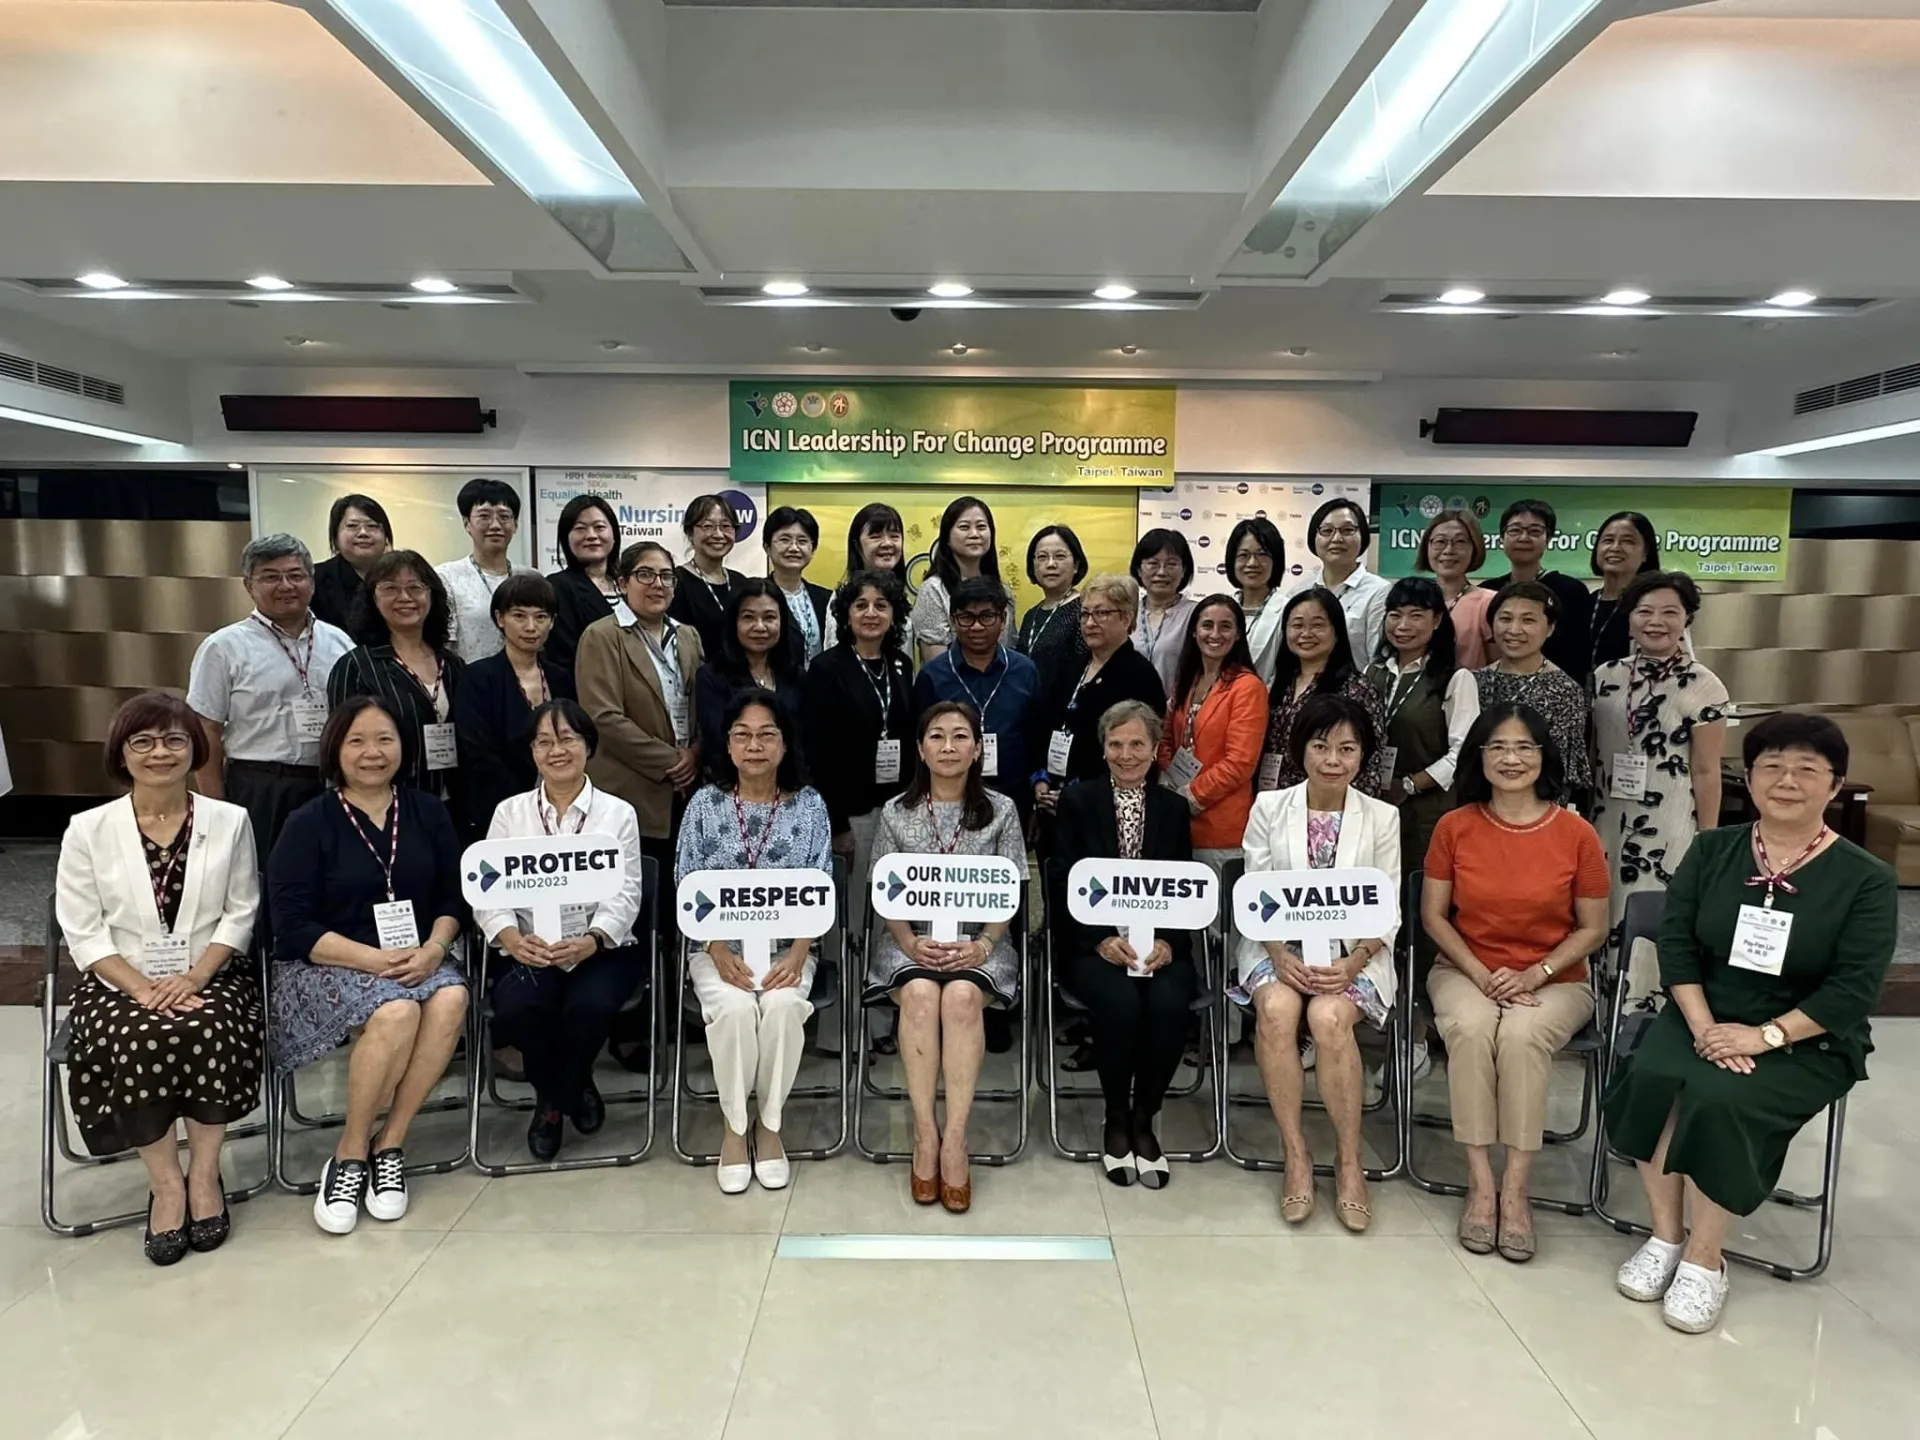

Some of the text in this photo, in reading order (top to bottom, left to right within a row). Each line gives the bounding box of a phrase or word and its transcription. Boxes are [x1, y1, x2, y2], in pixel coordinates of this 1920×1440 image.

[743, 429, 1166, 460] ICN Leadership For Change Programme
[1120, 466, 1163, 477] Taiwan
[587, 489, 622, 500] Health
[619, 504, 687, 523] Nursin
[619, 525, 663, 536] Taiwan
[1391, 529, 1425, 549] ICN
[1665, 531, 1780, 557] Programme
[1738, 563, 1776, 573] Taiwan
[504, 849, 619, 876] PROTECT
[506, 876, 568, 889] #IND2023
[906, 865, 1016, 884] OUR NURSES.
[1112, 876, 1208, 898] INVEST
[1282, 885, 1379, 907] VALUE
[720, 886, 830, 908] RESPECT
[906, 890, 1016, 909] OUR FUTURE.
[1111, 899, 1169, 910] #IND2023
[720, 910, 780, 921] #IND2023
[1285, 910, 1347, 921] #IND2023
